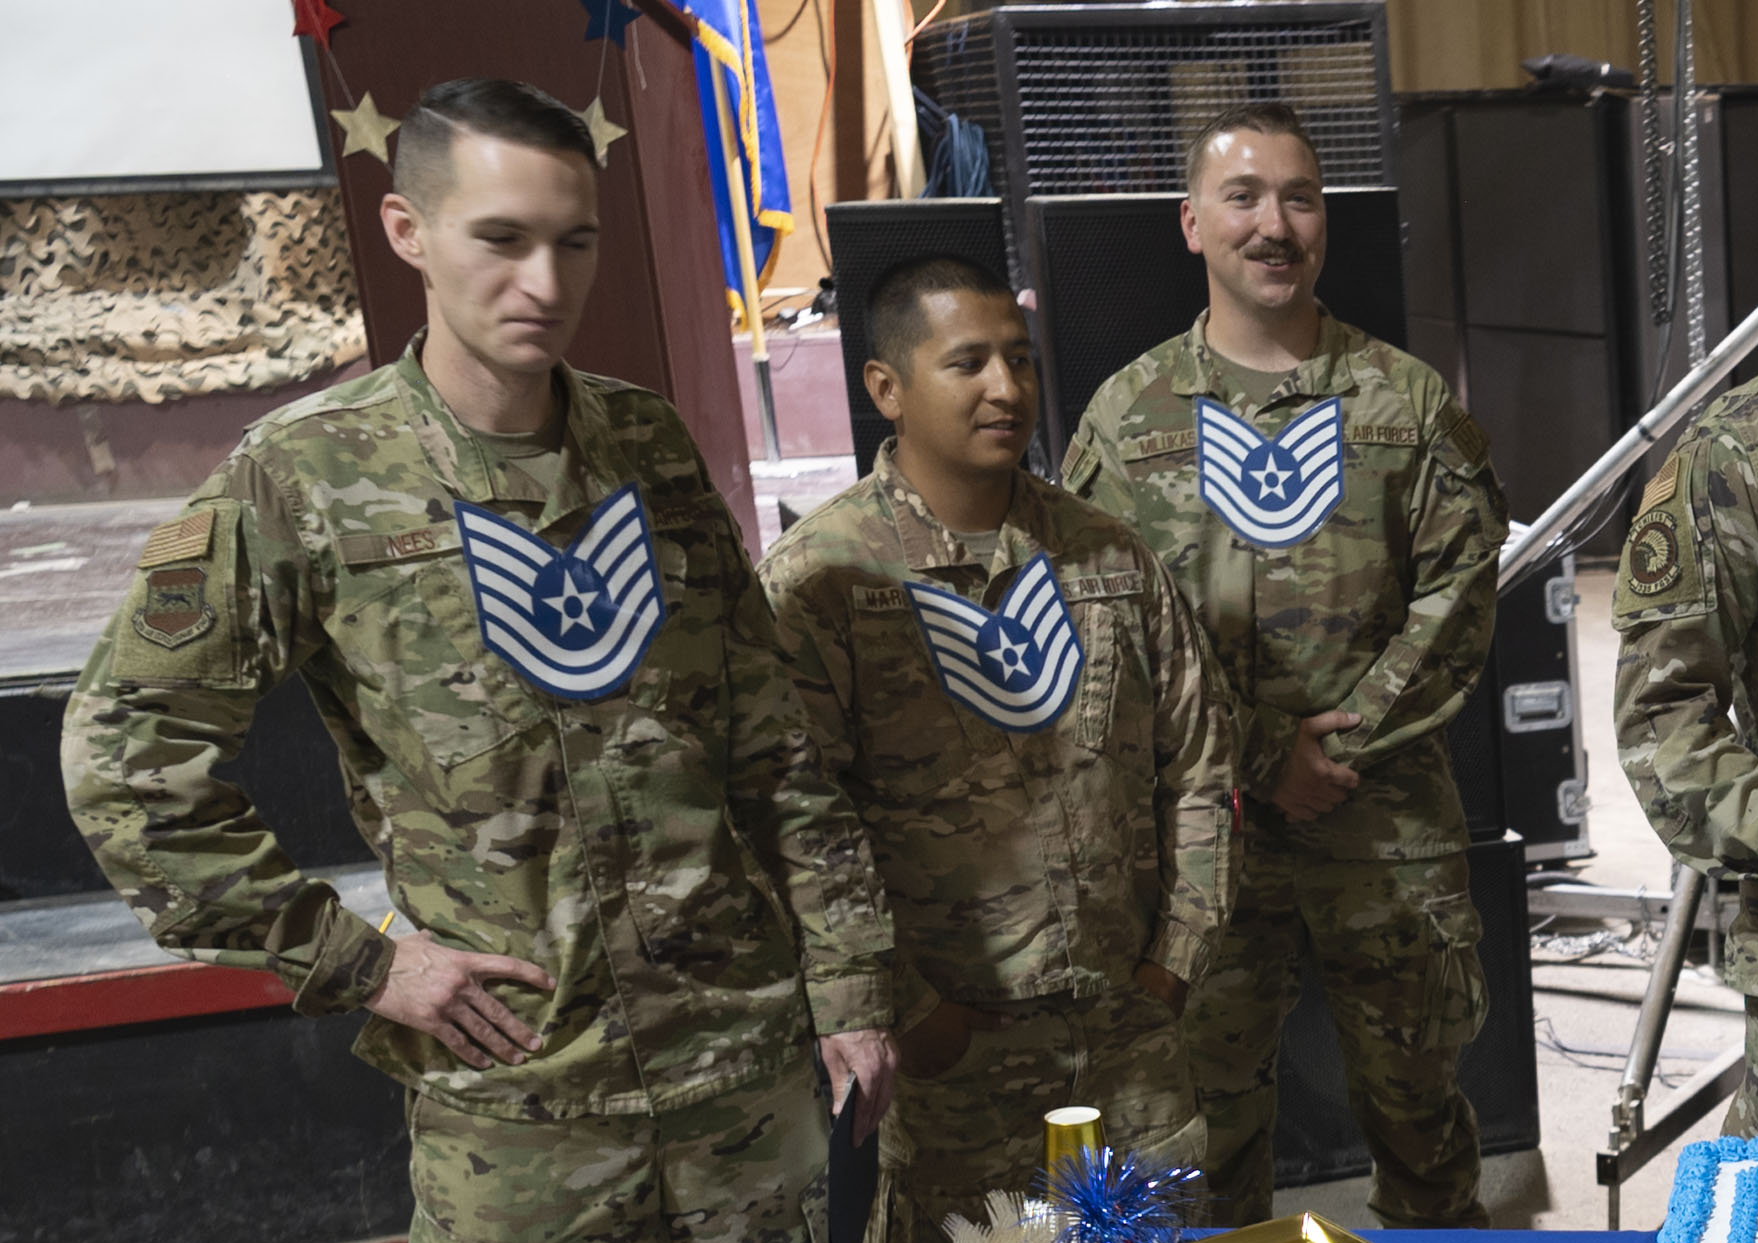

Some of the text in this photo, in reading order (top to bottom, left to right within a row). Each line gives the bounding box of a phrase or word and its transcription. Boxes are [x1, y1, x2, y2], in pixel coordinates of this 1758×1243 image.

[1353, 425, 1374, 441] AIR
[1377, 426, 1417, 443] FORCE
[386, 529, 436, 558] NEES
[1079, 579, 1101, 596] AIR
[1101, 574, 1141, 596] FORCE
